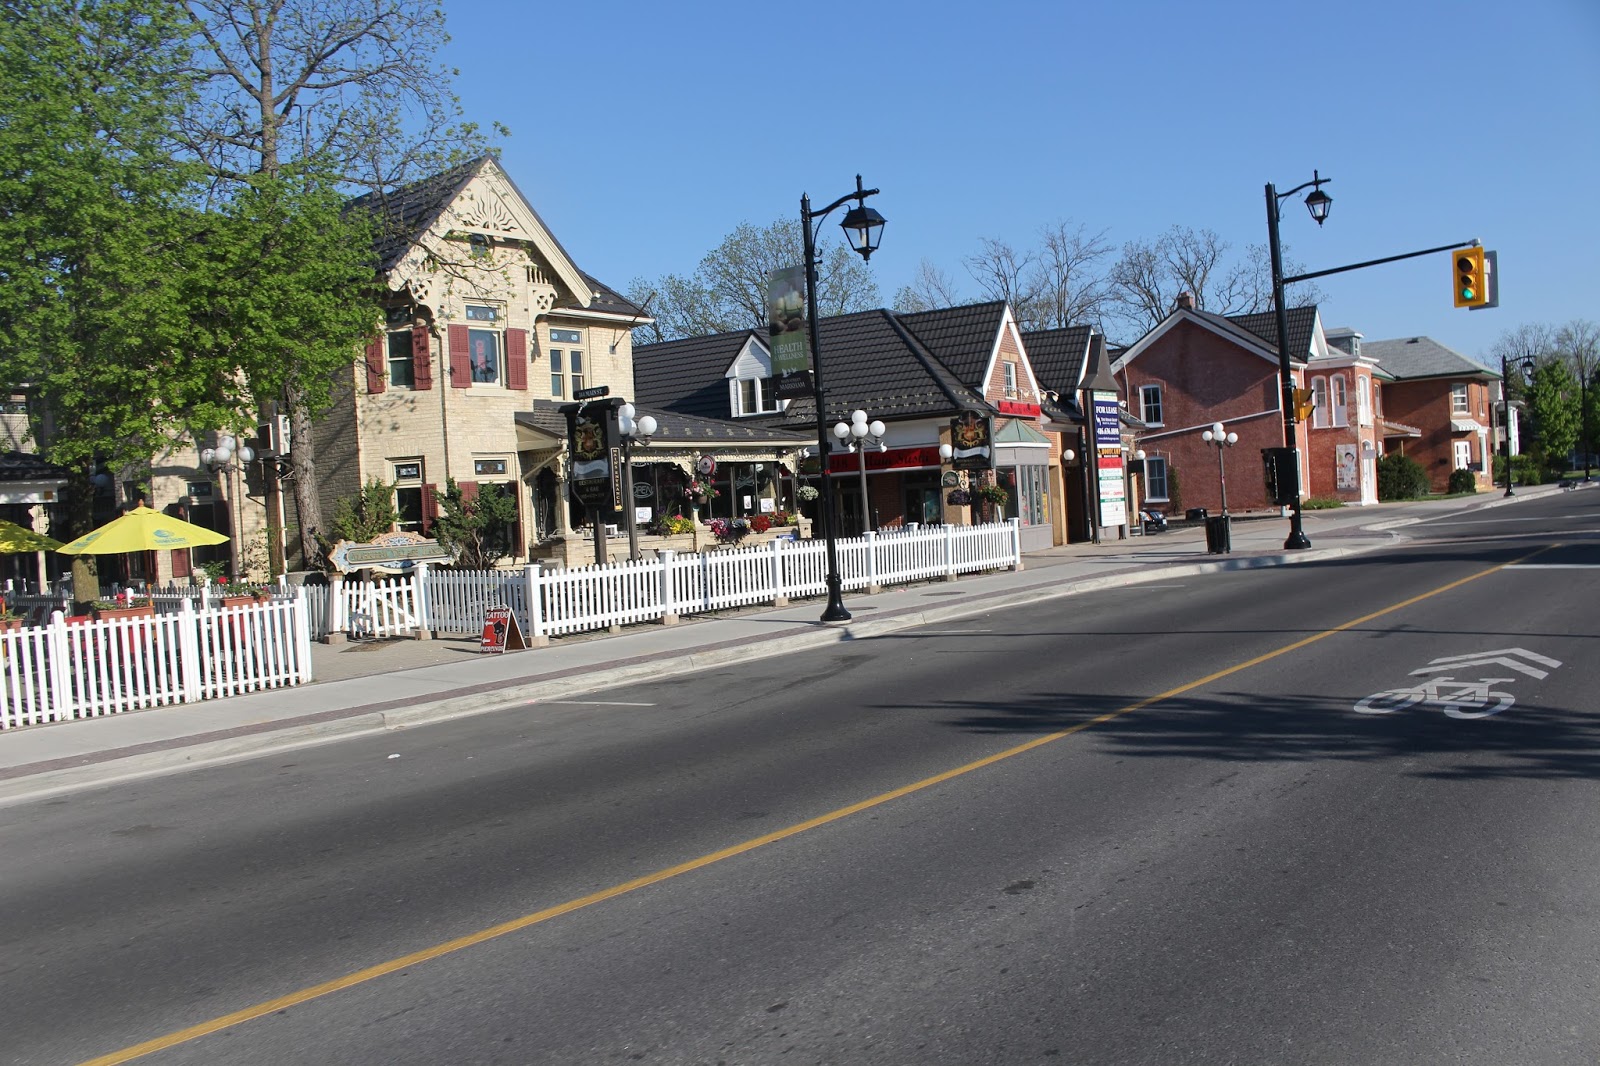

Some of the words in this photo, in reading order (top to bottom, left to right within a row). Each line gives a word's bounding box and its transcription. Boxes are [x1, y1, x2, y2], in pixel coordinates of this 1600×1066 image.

[774, 342, 803, 354] HEALTH
[778, 352, 803, 360] WELLNESS
[779, 382, 806, 390] MARKHAM
[1096, 405, 1106, 414] FOR
[1106, 406, 1118, 415] LEASE
[896, 451, 929, 465] Sushi
[486, 610, 509, 619] TATTOO
